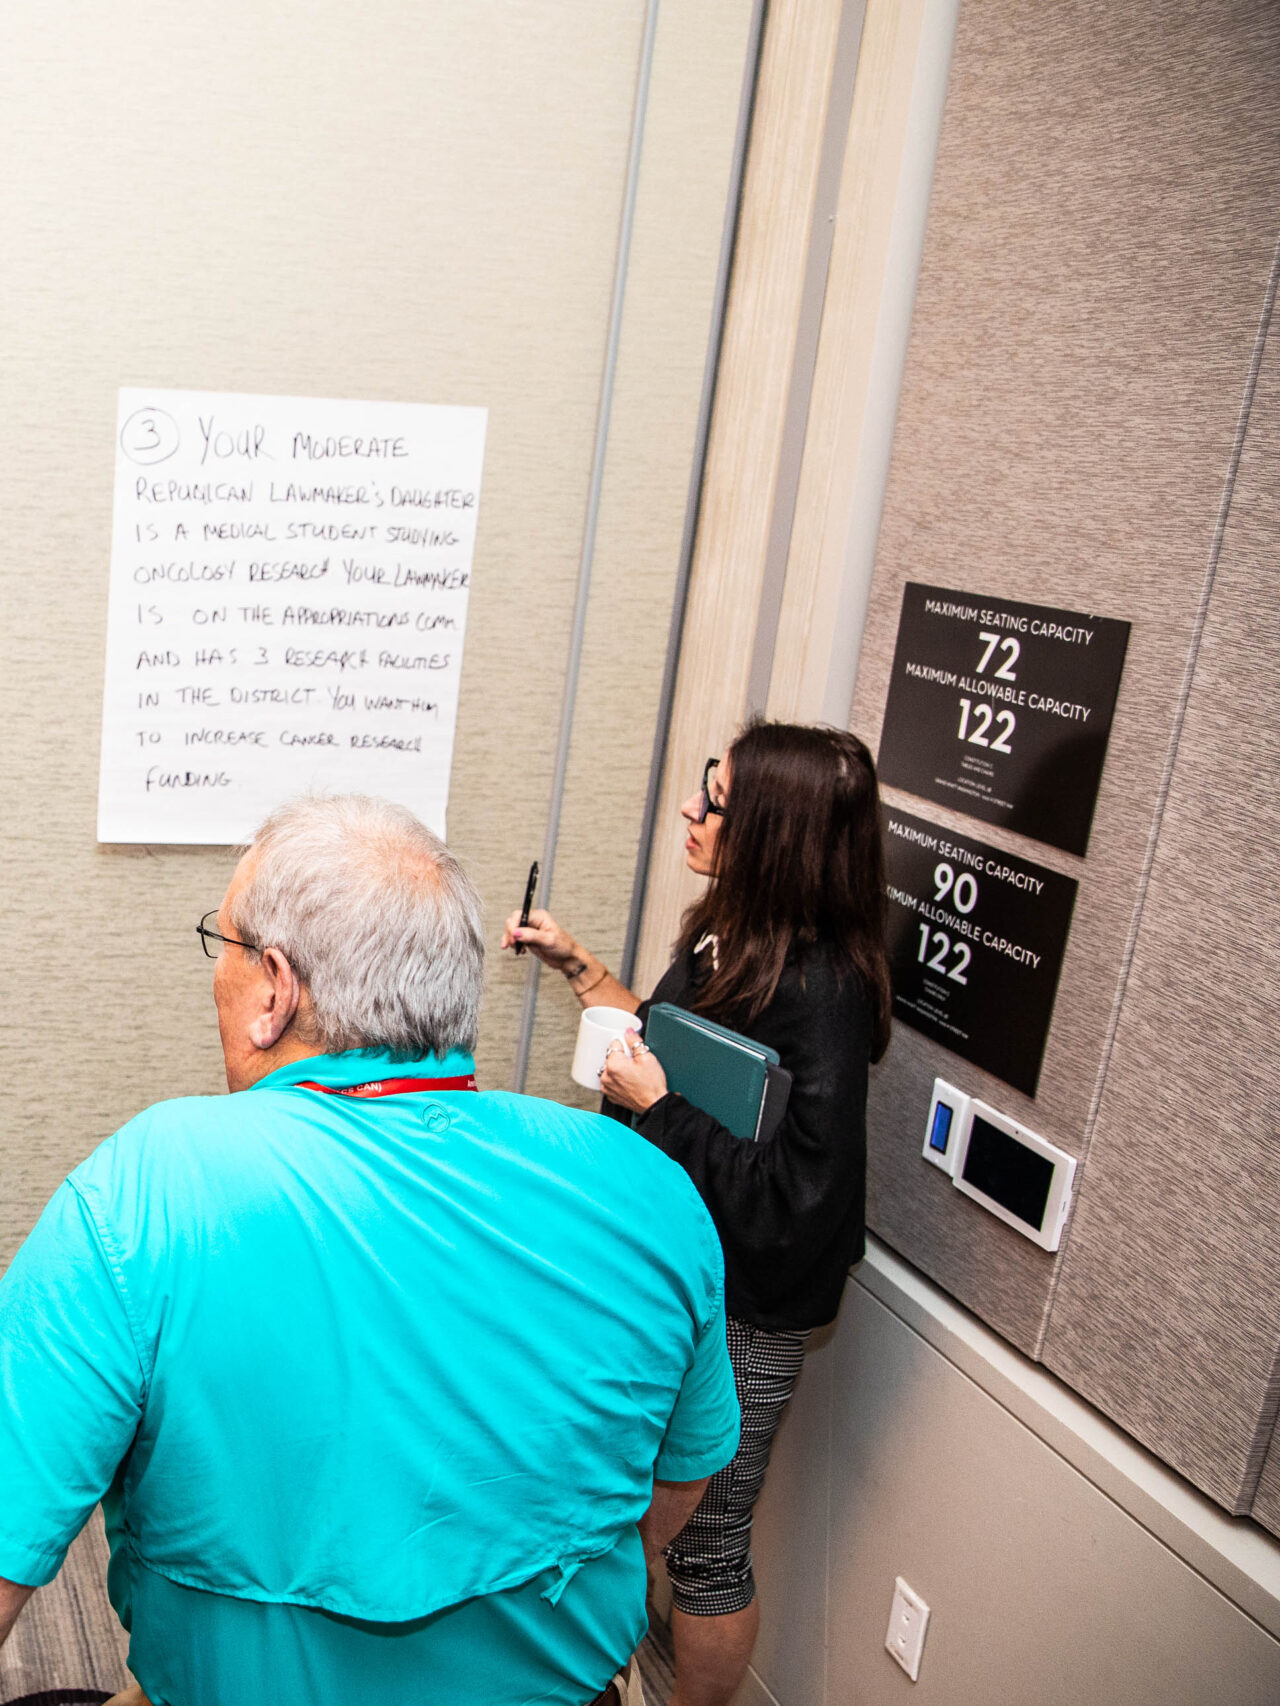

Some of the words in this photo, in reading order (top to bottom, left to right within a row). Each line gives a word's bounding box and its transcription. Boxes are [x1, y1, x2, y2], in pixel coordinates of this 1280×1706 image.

[198, 416, 275, 465] YOUR
[292, 432, 409, 460] MODERATE
[270, 481, 384, 508] LAWMAKER'S
[391, 486, 473, 510] DAUGHTER
[136, 523, 159, 543] IS
[175, 523, 189, 541] A
[203, 523, 276, 541] MEDICAL
[286, 522, 378, 541] STUDENT
[386, 526, 460, 547] STUDYING
[133, 560, 235, 584] ONCOLOGY
[249, 557, 330, 583] RESEARCH
[342, 558, 393, 586] YOUR
[138, 604, 163, 625] IS
[192, 607, 226, 625] ON
[238, 604, 274, 626] THE
[925, 600, 978, 621] MAXIMUM
[979, 610, 1027, 633] SEATING
[1031, 620, 1094, 645] CAPACITY
[136, 650, 180, 670] AND
[195, 648, 237, 667] HAS
[254, 650, 269, 665] 3
[285, 647, 368, 672] RESEARCH
[976, 632, 1020, 681] 72
[138, 692, 159, 709] IN
[176, 686, 220, 707] THE
[328, 685, 355, 711] YOU
[364, 696, 413, 712] WANT
[906, 662, 957, 687] MAXIMUM
[958, 676, 1025, 706] ALLOWABLE
[1028, 694, 1091, 722] CAPACITY
[136, 731, 161, 747] TO
[185, 730, 268, 748] INCREASE
[279, 730, 340, 747] CANCER
[350, 735, 422, 753] RESEARCH
[958, 698, 1016, 754] 122
[888, 820, 937, 851] MAXIMUM
[938, 840, 984, 870] SEATING
[986, 860, 1044, 895] CAPACITY
[934, 862, 978, 914] 90
[886, 884, 917, 910] IMUM
[918, 902, 980, 942] ALLOWABLE
[983, 932, 1040, 969] CAPACITY
[918, 923, 971, 986] 122
